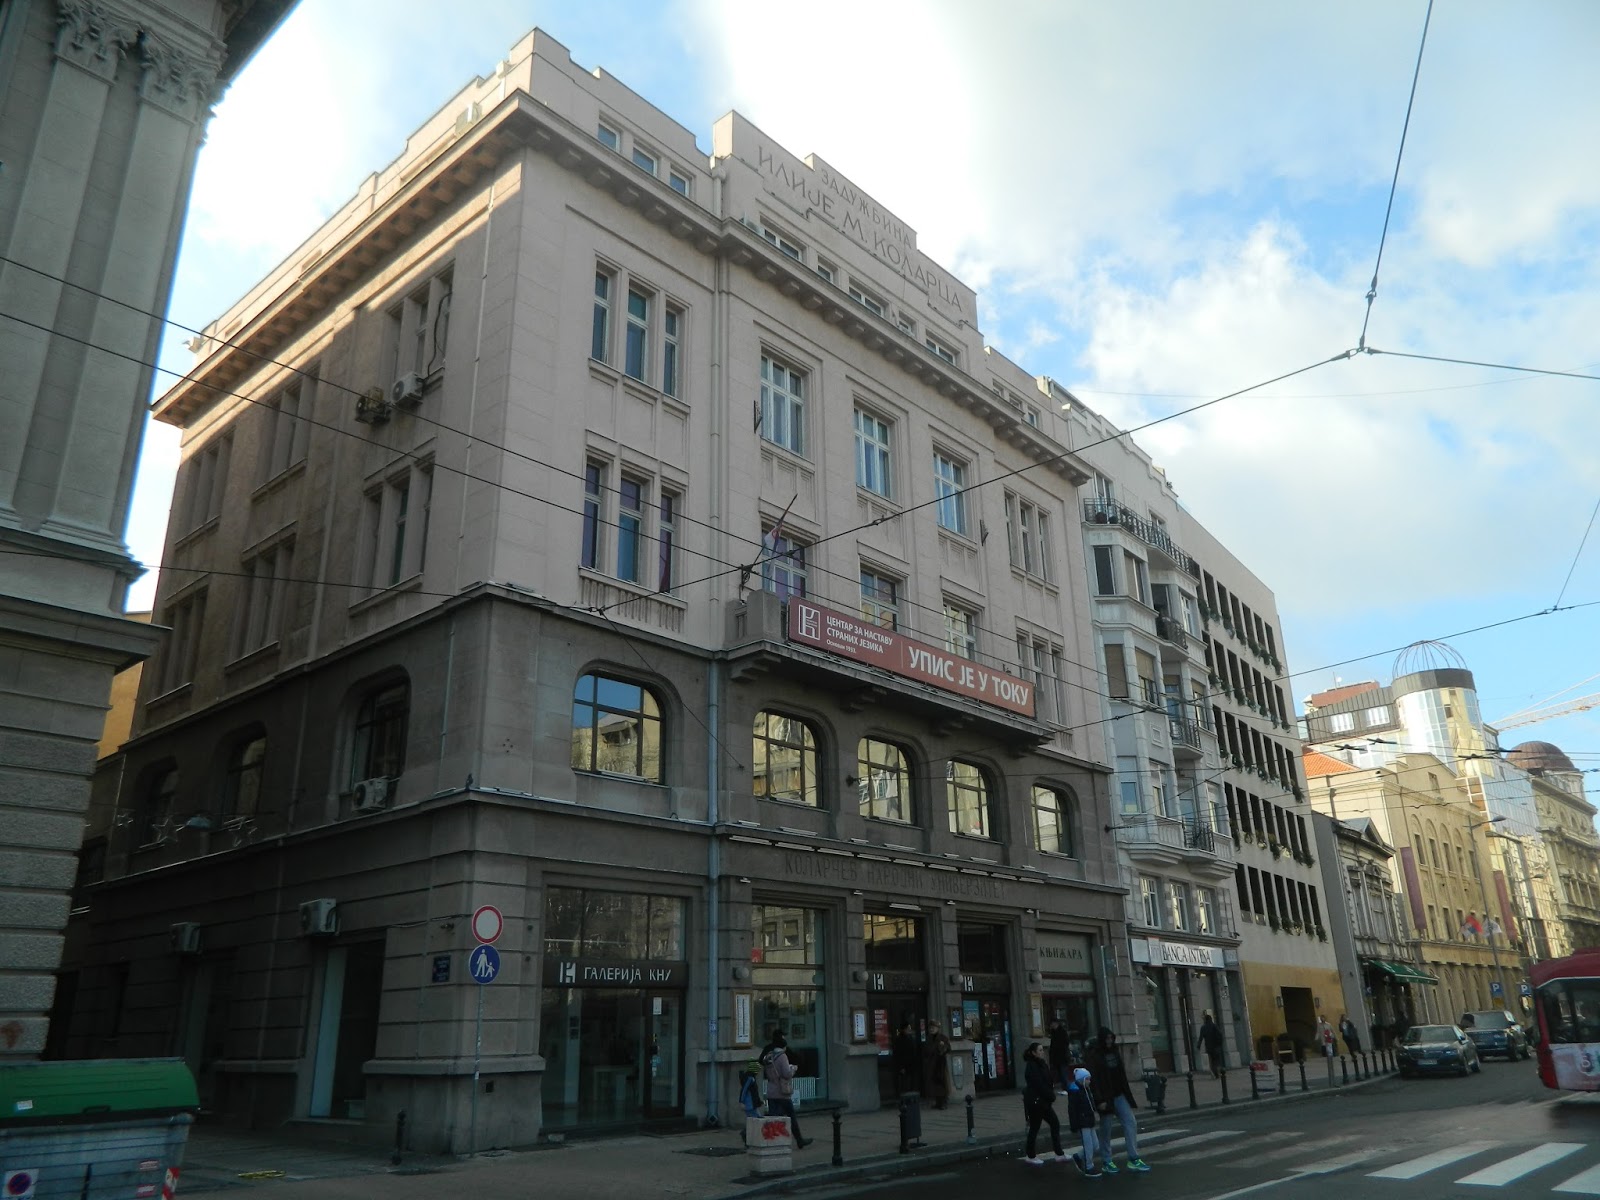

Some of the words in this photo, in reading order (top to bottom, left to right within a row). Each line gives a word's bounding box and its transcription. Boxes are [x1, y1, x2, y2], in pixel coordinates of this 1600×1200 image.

[821, 168, 912, 249] ЗАДУЖБИНА
[758, 146, 835, 220] ИЛИЈЕ
[874, 231, 963, 312] КОЛАРЦА
[826, 615, 854, 632] ЦЕНТАР
[854, 625, 864, 636] ЗА
[864, 628, 893, 646] НАСТАВУ
[826, 627, 859, 645] СТРАНИХ
[859, 638, 884, 654] ЈЕЗИКА
[908, 646, 955, 682] УПИС
[958, 665, 975, 689] ЈЕ
[978, 670, 988, 692] У
[992, 676, 1029, 706] ТОКУ
[785, 853, 857, 881] КОЛАРЧЕВ
[1039, 946, 1083, 960] КЊИЖАРА
[1162, 944, 1187, 962] BANCA
[649, 968, 672, 981] КНУ
